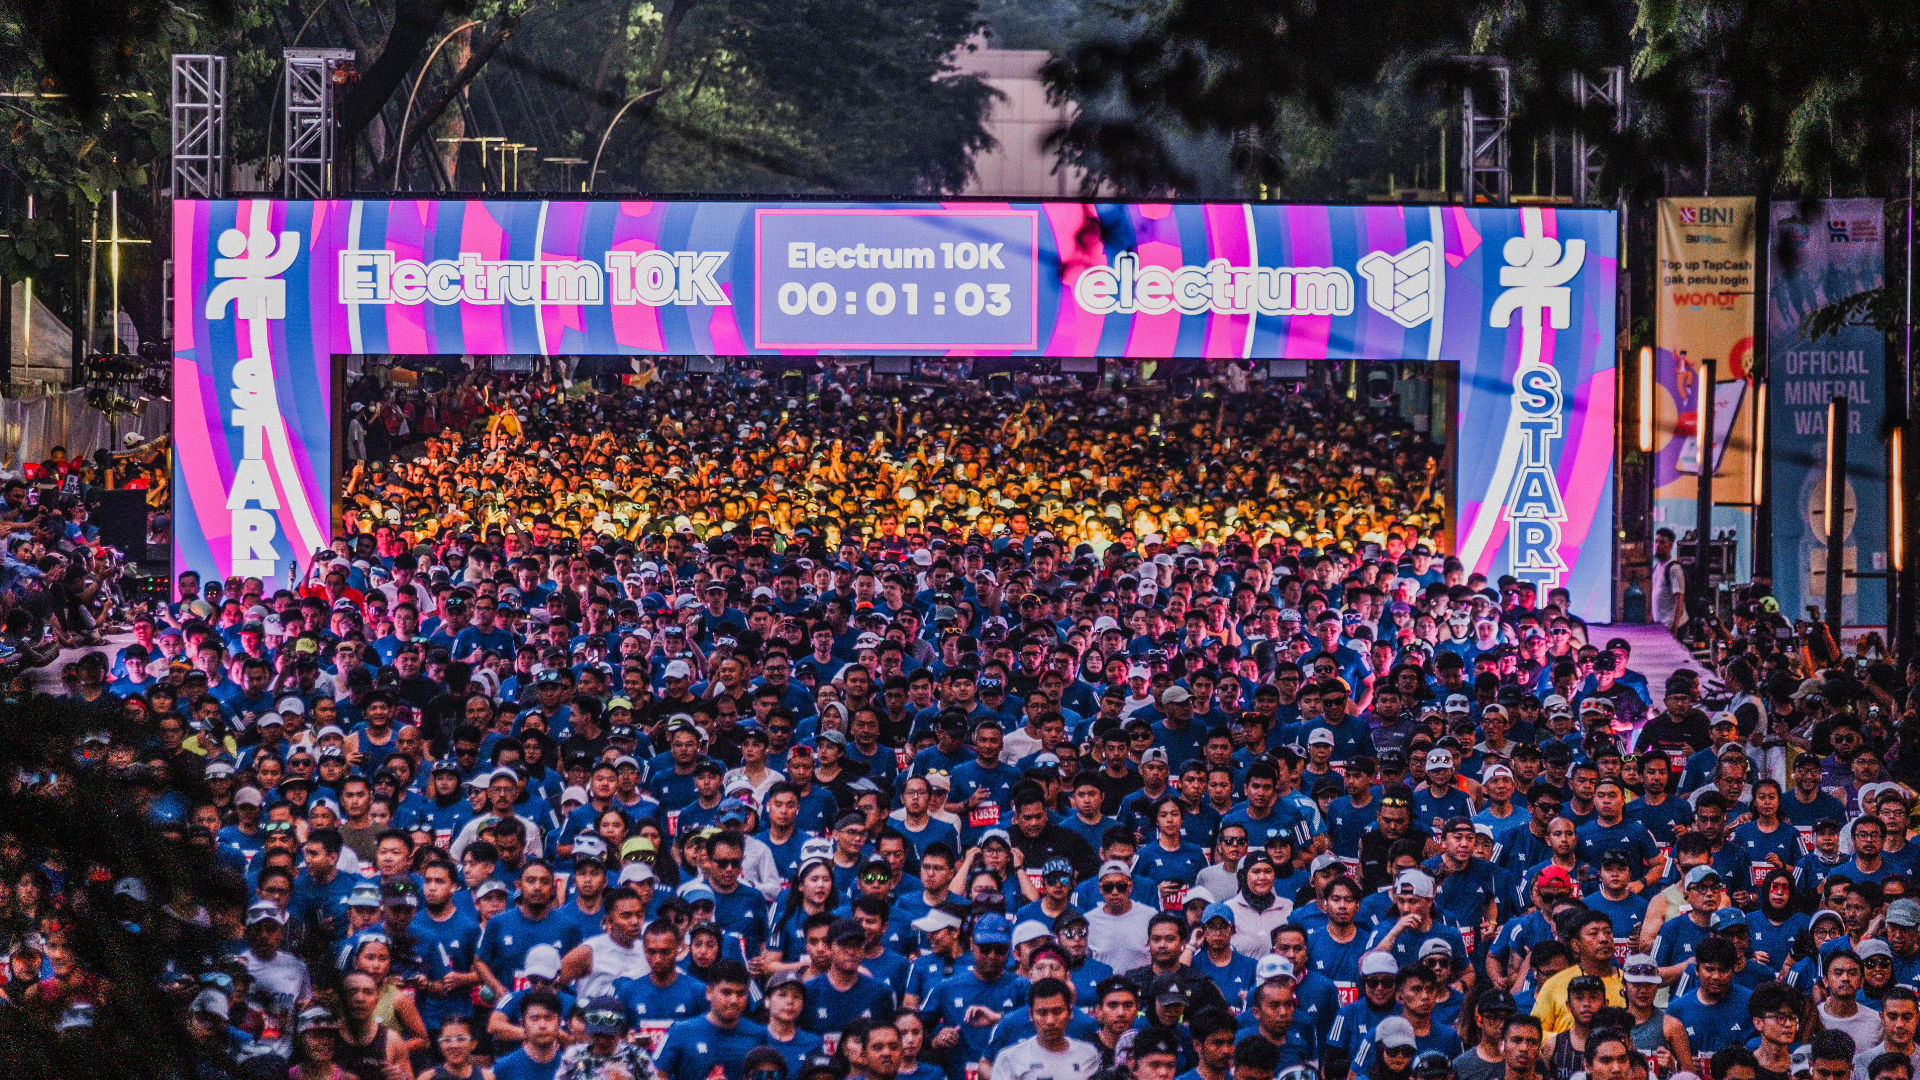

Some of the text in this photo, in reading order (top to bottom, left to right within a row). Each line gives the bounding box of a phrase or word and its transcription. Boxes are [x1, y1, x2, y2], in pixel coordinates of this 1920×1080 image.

[1700, 206, 1734, 223] BNI
[788, 242, 1006, 269] Electrum 10K
[1661, 260, 1752, 272] Top up TapCash
[339, 250, 732, 306] Electrum 10K
[1075, 251, 1354, 316] electrum
[1664, 275, 1749, 288] gak perlu login
[1673, 289, 1740, 307] wondr
[1786, 350, 1869, 375] OFFICIAL
[1785, 380, 1871, 405] MINERAL
[1794, 411, 1860, 435] WAR
